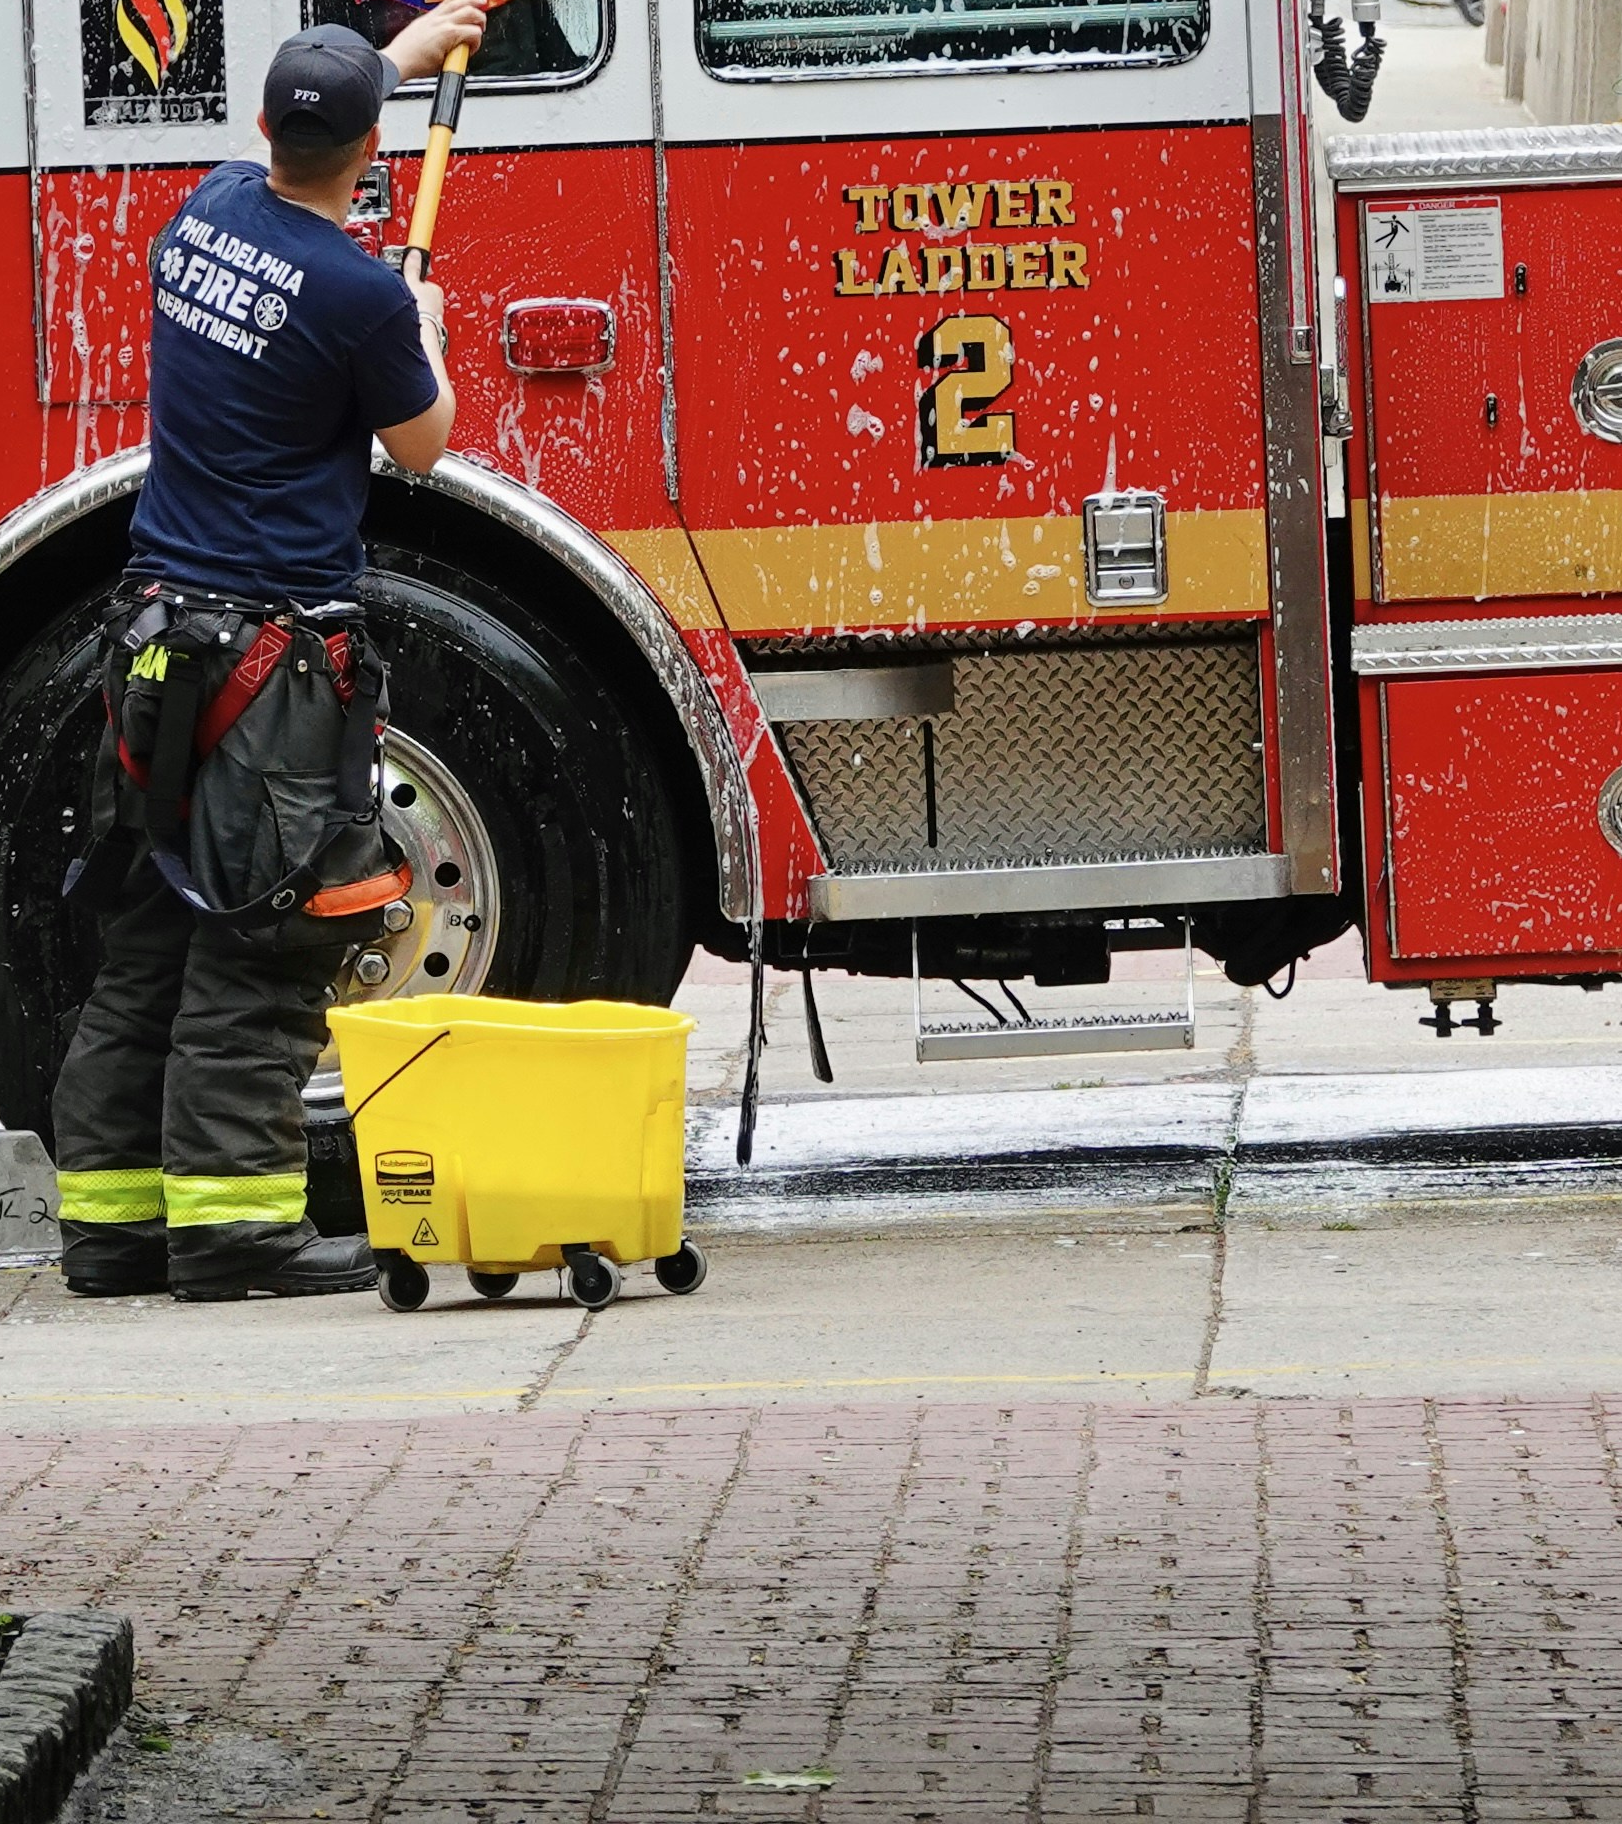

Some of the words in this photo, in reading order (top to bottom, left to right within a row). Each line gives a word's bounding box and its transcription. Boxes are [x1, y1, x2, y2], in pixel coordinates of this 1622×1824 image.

[294, 88, 320, 103] PFD
[843, 179, 1077, 234] TOWER
[175, 214, 305, 297] PHILADELPHIA
[181, 254, 261, 323] FIRE
[834, 240, 1091, 297] LADDER
[156, 291, 269, 361] DEPARTMENT
[917, 313, 1018, 468] 2
